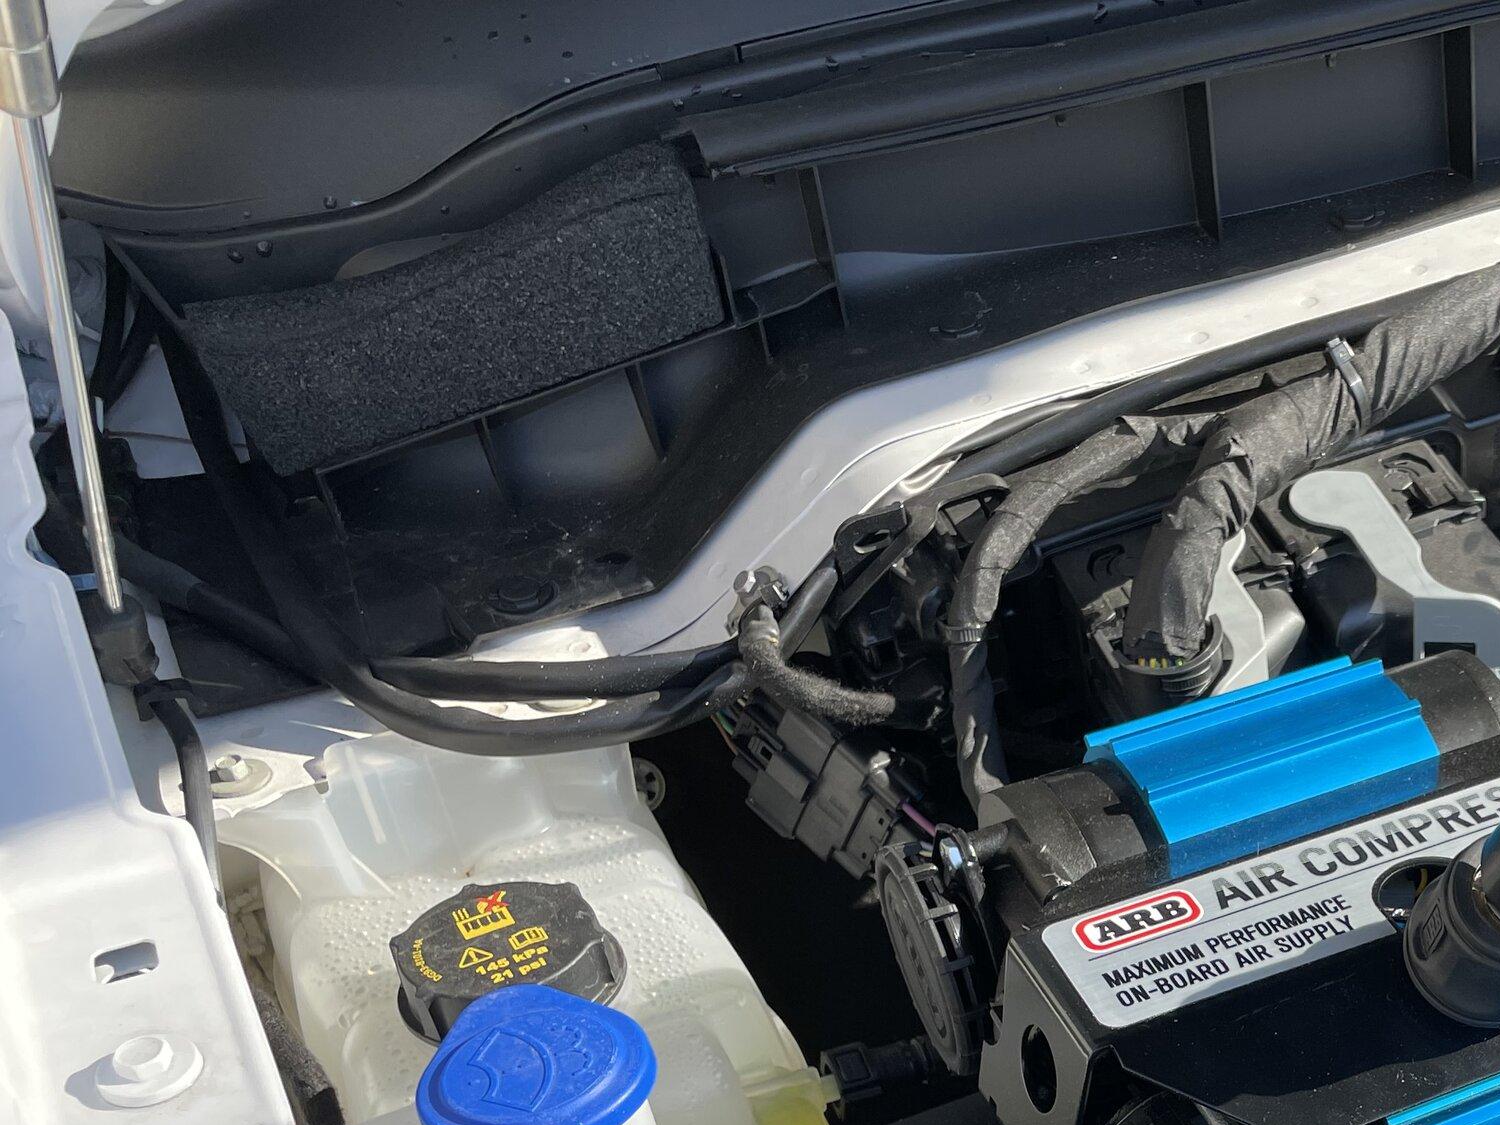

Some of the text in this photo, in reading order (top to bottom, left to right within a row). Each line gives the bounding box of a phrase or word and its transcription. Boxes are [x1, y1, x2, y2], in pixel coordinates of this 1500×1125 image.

[1211, 859, 1298, 909] AIR
[1097, 898, 1189, 942] ARB
[1102, 894, 1353, 989] MAXIMUM PERFORMANCE
[475, 946, 549, 975] 145 kPa
[490, 957, 547, 984] 21 psi
[1116, 915, 1357, 1007] ON-BOARD AIR SUPPLY
